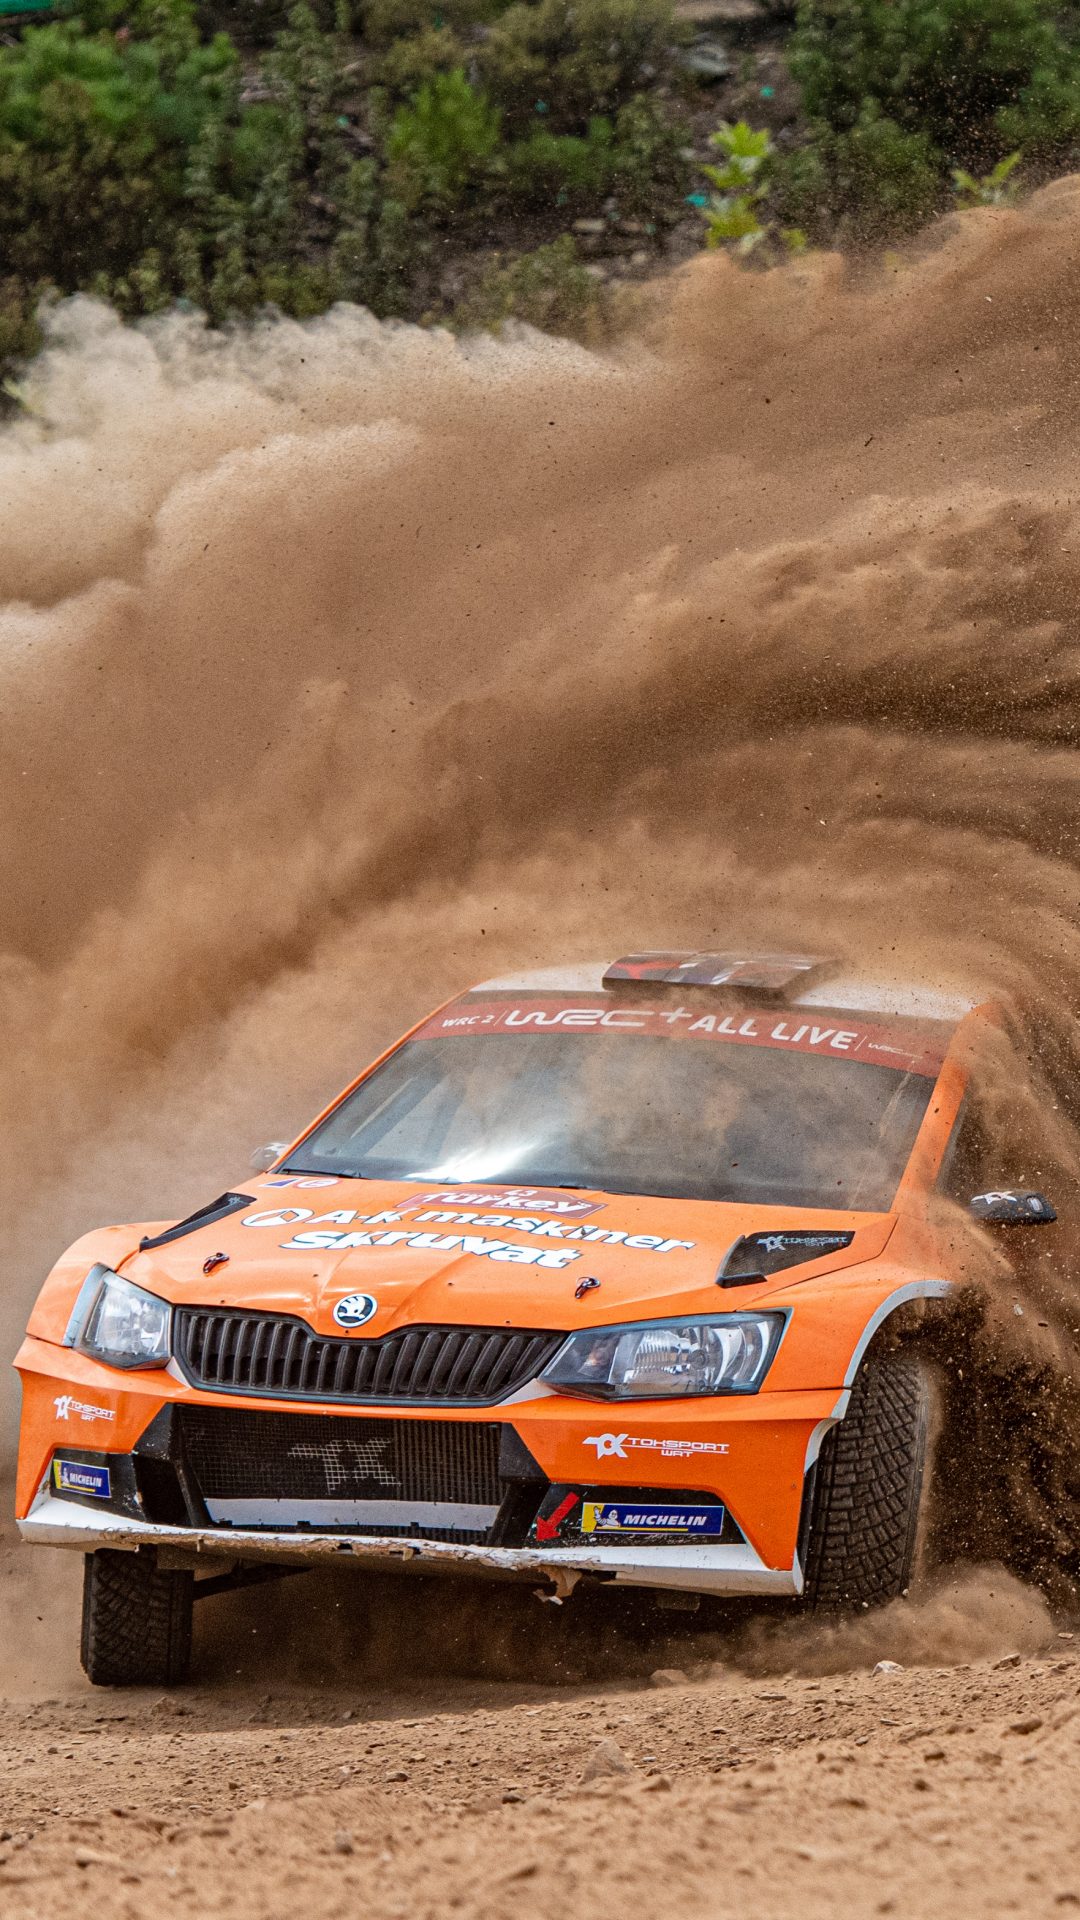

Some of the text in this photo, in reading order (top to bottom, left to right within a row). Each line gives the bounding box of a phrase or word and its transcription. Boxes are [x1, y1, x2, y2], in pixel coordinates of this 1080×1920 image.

[442, 1015, 495, 1027] WRC 2
[688, 1015, 758, 1036] ALL
[771, 1023, 858, 1049] LIVE
[422, 1192, 592, 1213] Turkey
[412, 1210, 696, 1252] maskiner
[278, 1231, 583, 1268] Skruvat
[69, 1472, 102, 1488] MICHELIN
[623, 1514, 707, 1527] MICHELIN
